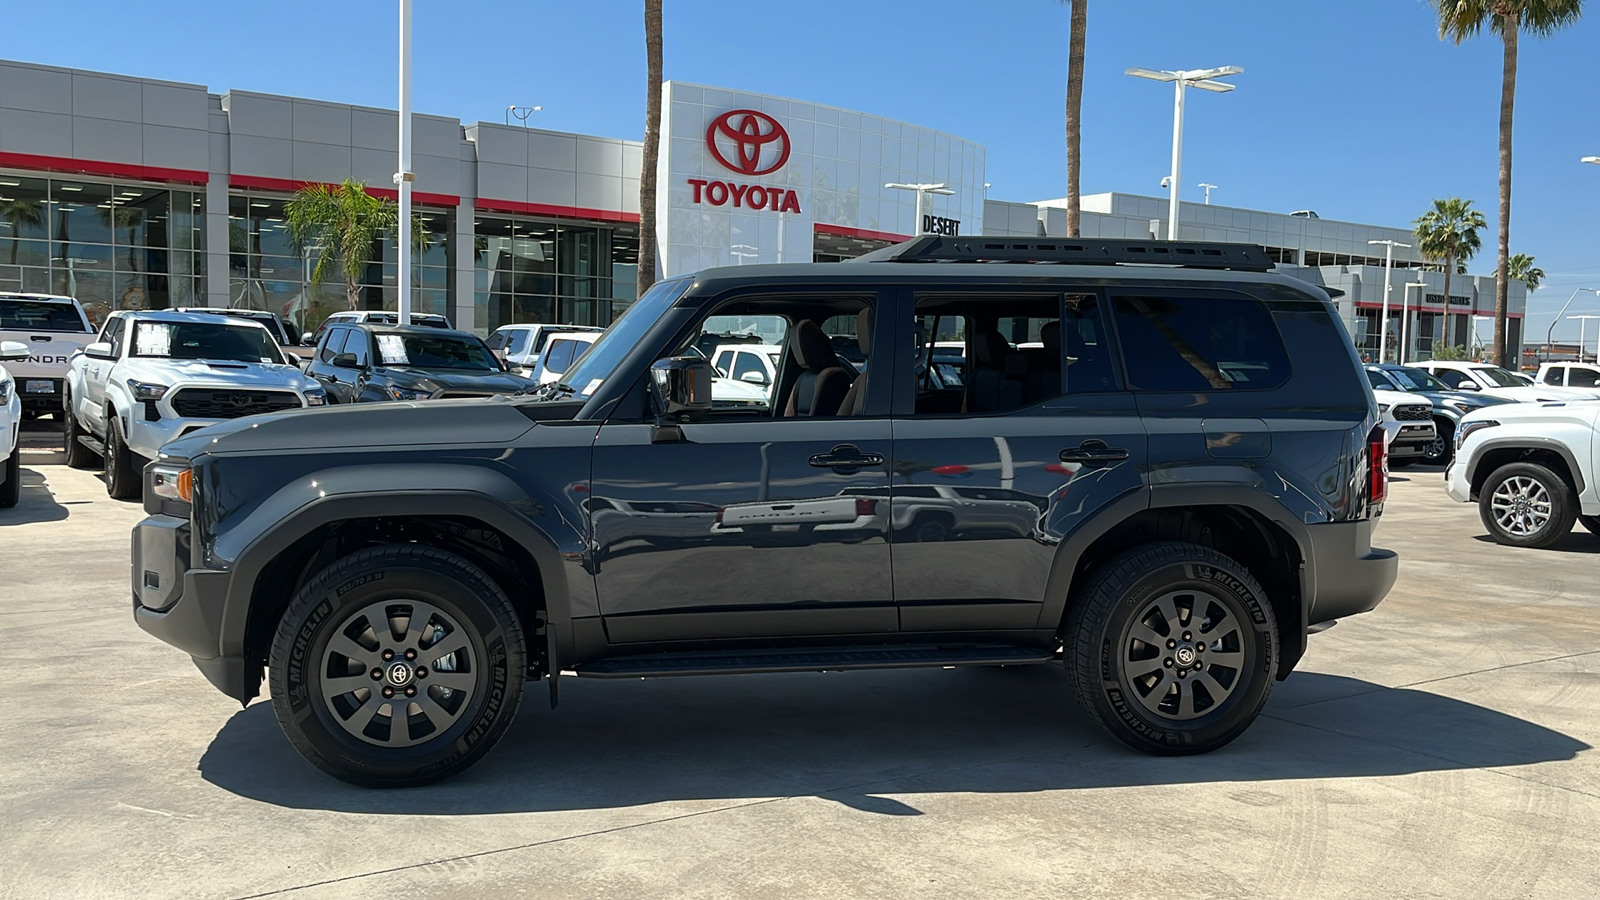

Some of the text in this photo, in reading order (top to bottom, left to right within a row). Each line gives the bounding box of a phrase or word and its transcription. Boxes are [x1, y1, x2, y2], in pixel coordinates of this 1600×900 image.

[687, 179, 801, 214] TOYOTA
[923, 214, 961, 236] DESERT
[1213, 571, 1264, 622] MICHELIN
[290, 602, 330, 683] MICHELIN
[468, 666, 505, 744] MICHELIN
[1110, 691, 1163, 740] MICHELIN
